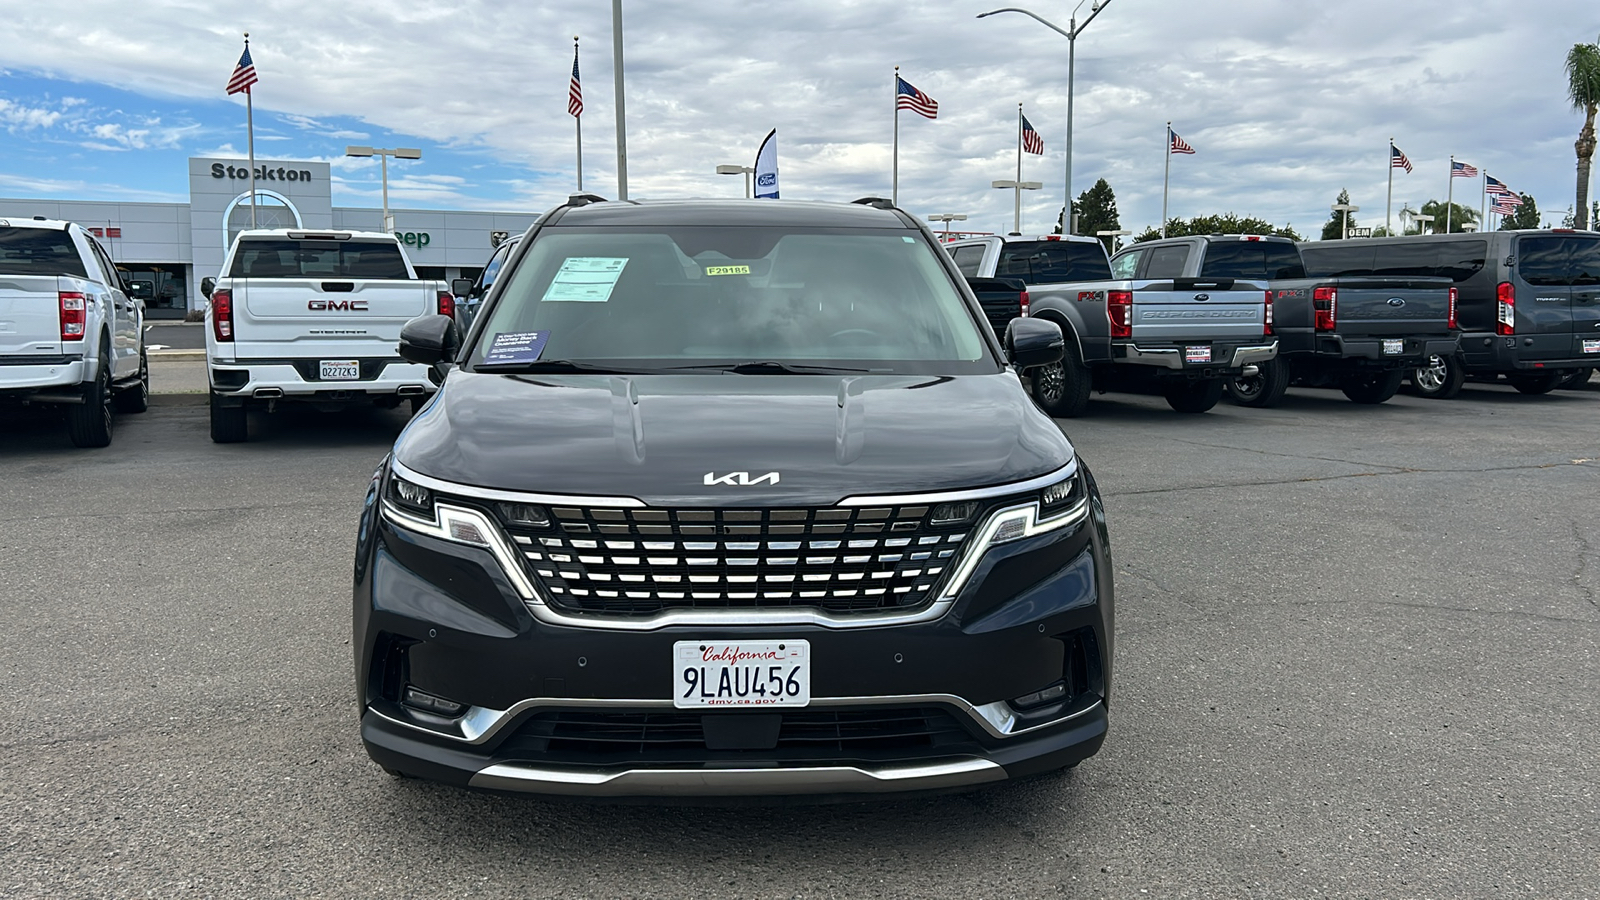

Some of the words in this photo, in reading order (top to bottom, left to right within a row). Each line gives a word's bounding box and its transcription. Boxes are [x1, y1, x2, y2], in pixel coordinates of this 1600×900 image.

[211, 163, 311, 181] Stockton
[759, 174, 776, 186] Ford
[1349, 229, 1370, 237] OEM
[394, 230, 430, 249] eep
[1078, 290, 1104, 302] FX4
[1278, 289, 1306, 299] FX4
[308, 300, 368, 311] GMC
[1143, 310, 1206, 319] SUPER
[1209, 310, 1255, 319] DUTY
[322, 368, 357, 377] 02272K3
[703, 471, 780, 486] KIA
[702, 646, 785, 665] California
[683, 665, 801, 698] 9LAU456
